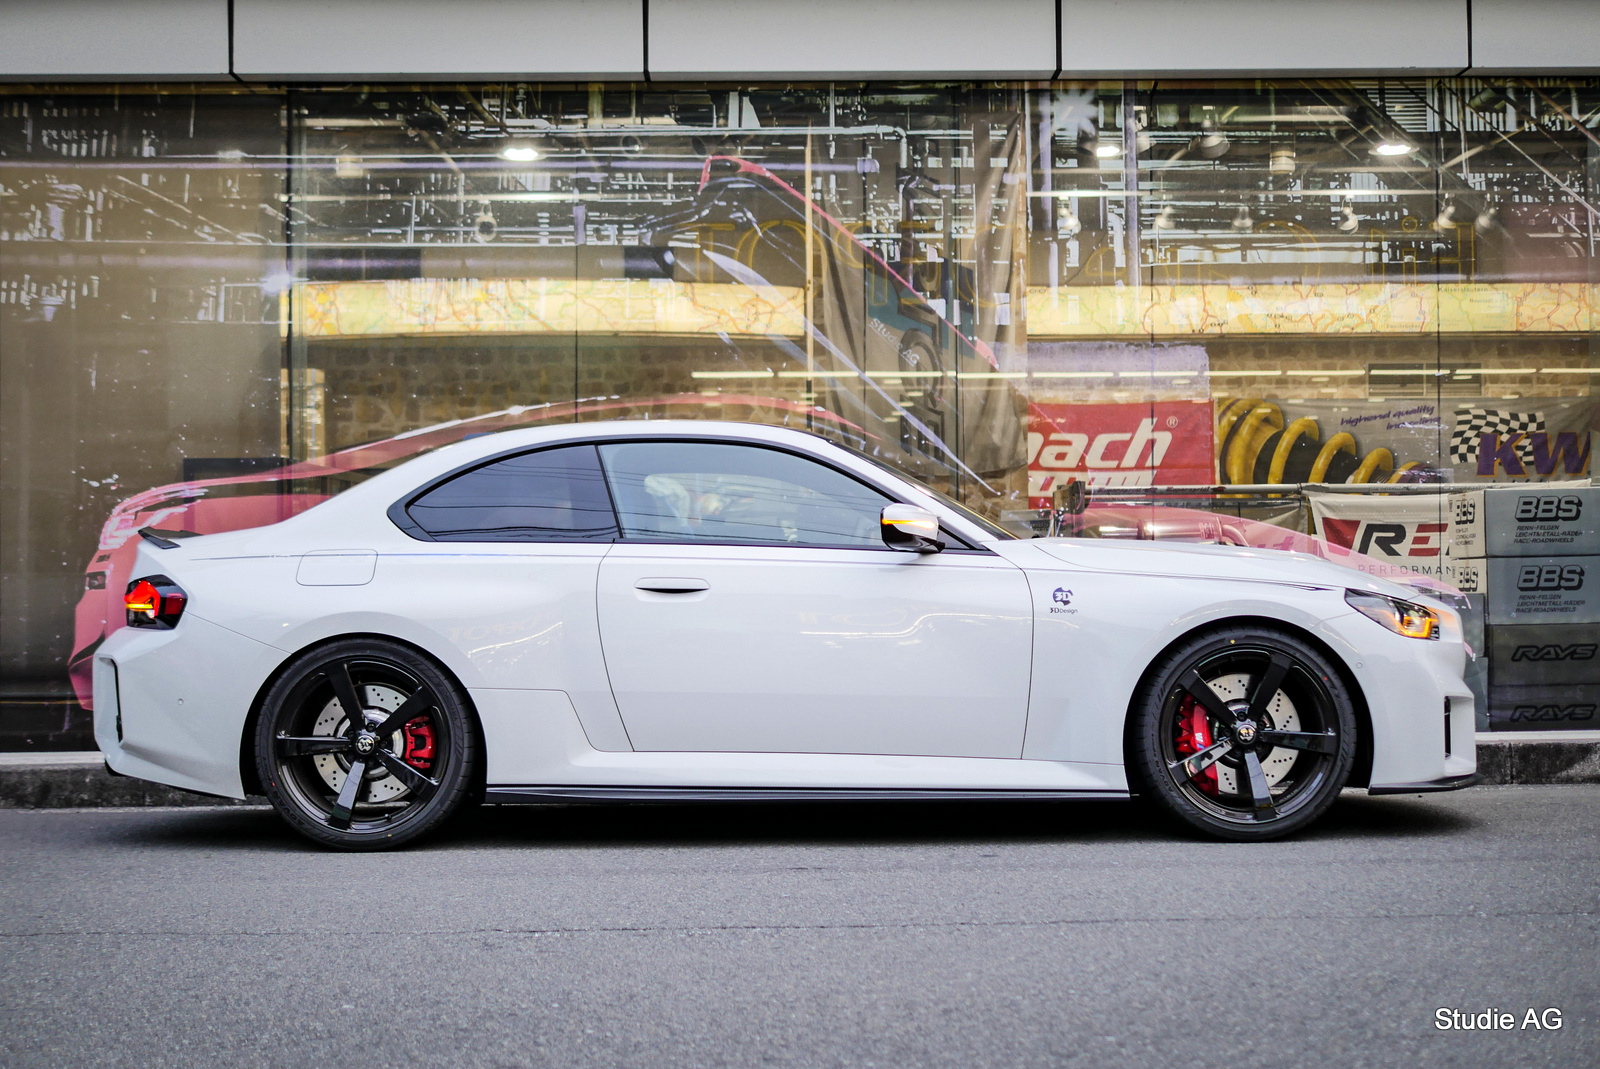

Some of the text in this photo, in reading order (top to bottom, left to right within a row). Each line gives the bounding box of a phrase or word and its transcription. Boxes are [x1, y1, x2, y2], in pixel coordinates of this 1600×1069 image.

[1341, 405, 1435, 426] highend quality
[1476, 431, 1590, 477] KW
[1455, 498, 1476, 525] BBS
[1515, 495, 1583, 522] BBS
[1358, 523, 1449, 556] RE
[1458, 566, 1478, 592] BBS
[1517, 564, 1585, 591] BBS
[1511, 643, 1598, 662] RAYS
[1509, 703, 1597, 722] RAYS
